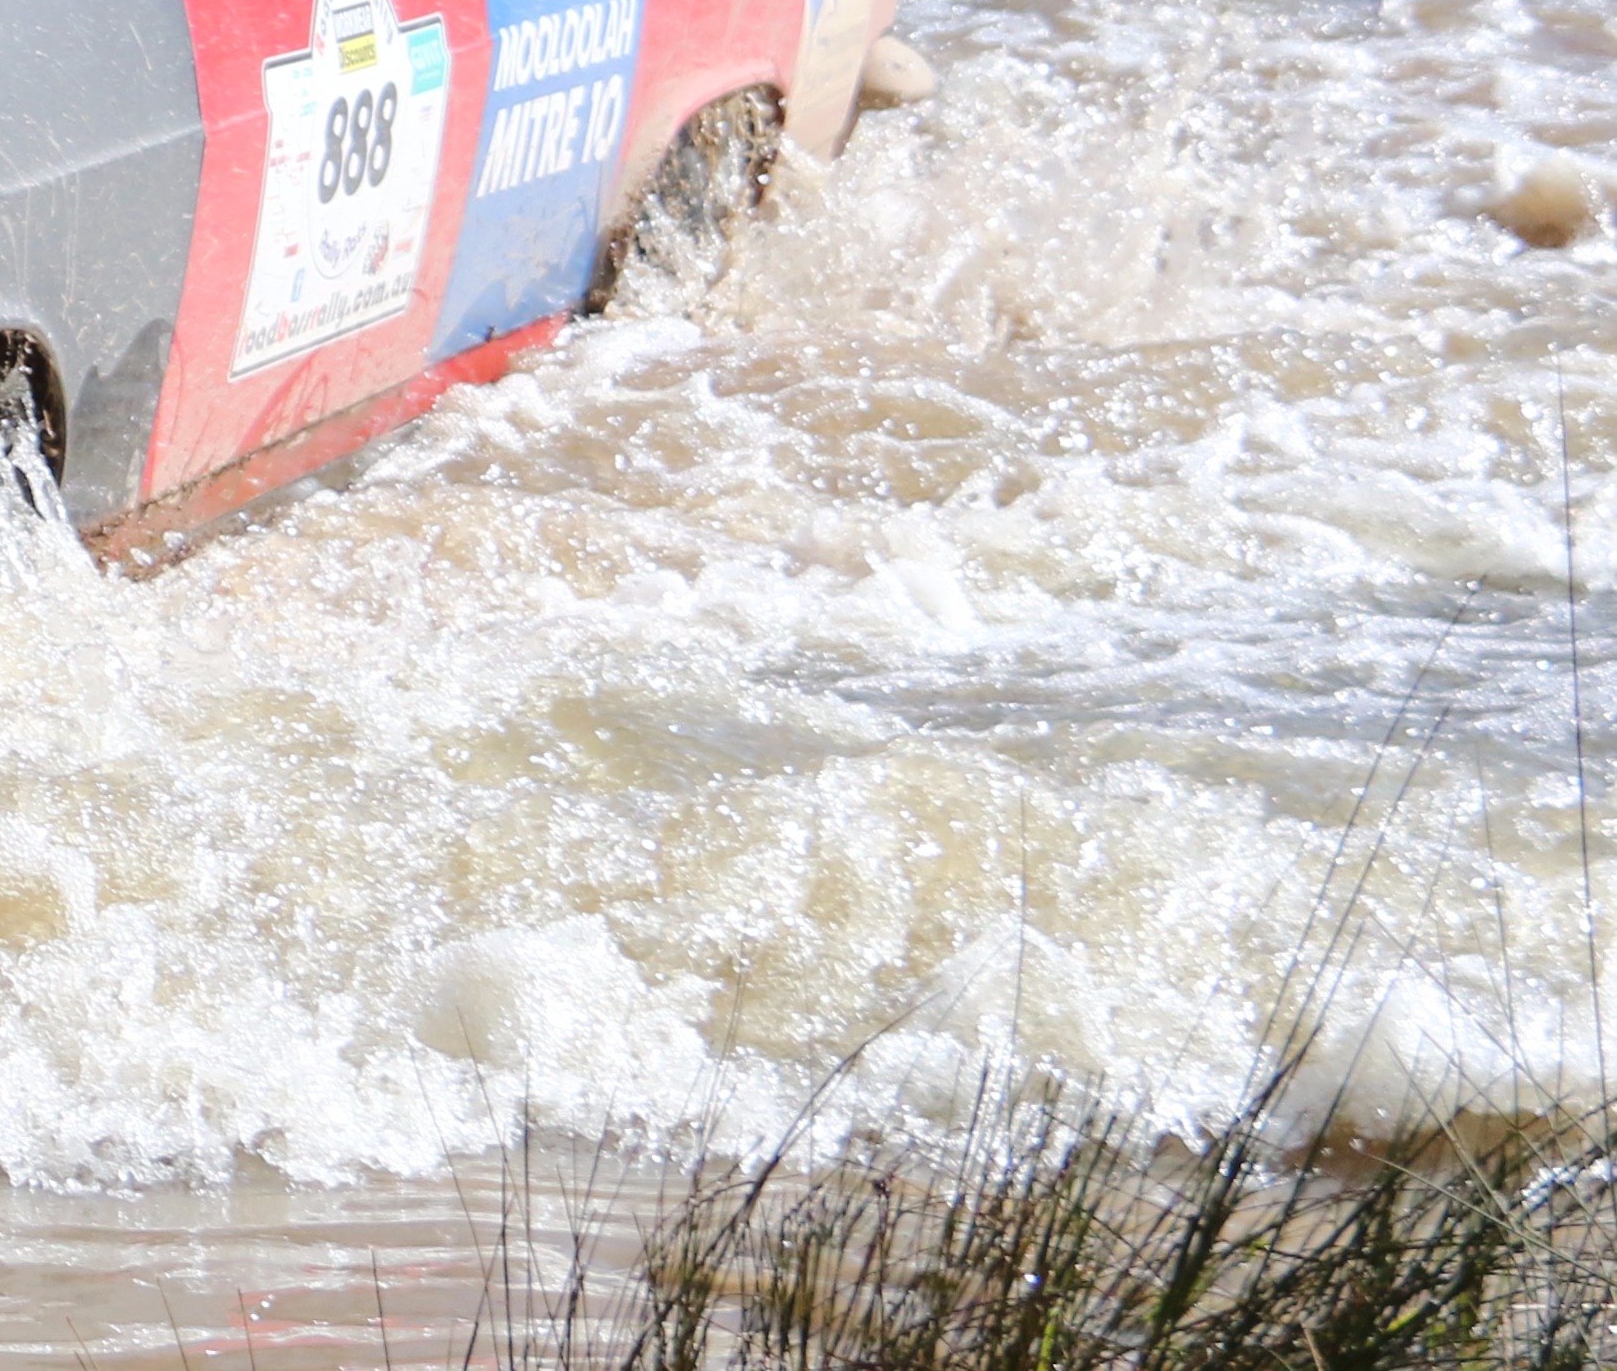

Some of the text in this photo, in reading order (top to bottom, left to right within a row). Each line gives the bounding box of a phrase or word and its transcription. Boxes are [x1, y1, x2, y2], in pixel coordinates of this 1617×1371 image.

[317, 80, 398, 205] 888
[476, 73, 625, 198] MITRE 10
